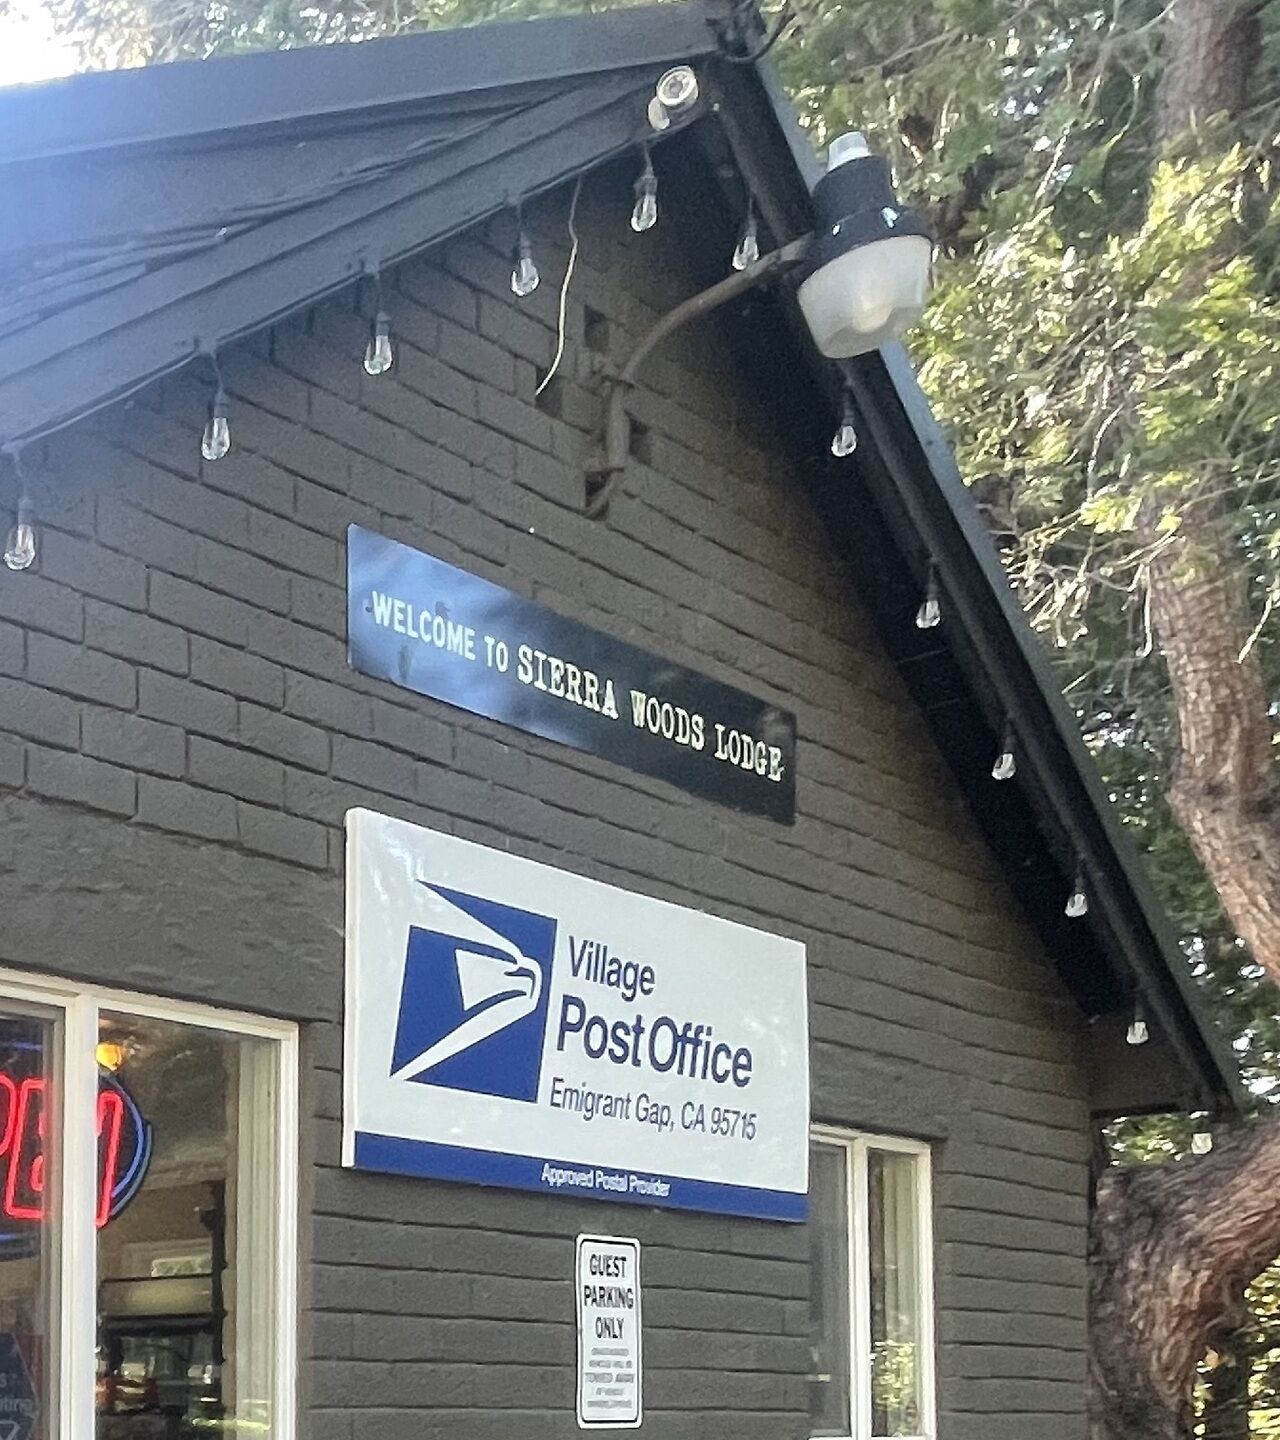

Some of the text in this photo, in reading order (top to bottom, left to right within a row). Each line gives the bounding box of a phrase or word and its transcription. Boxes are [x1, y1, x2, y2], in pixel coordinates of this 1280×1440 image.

[371, 590, 784, 783] WELCOME TO SIERRA WOODS LODGE
[568, 935, 656, 1002] Village
[556, 994, 752, 1088] Post Office
[550, 1077, 757, 1141] Emigrant Gap, CA 95715
[541, 1163, 671, 1198] Approved Postal Provider
[590, 1254, 627, 1278] GUEST
[584, 1285, 634, 1309] PARKING
[595, 1316, 624, 1339] ONLY
